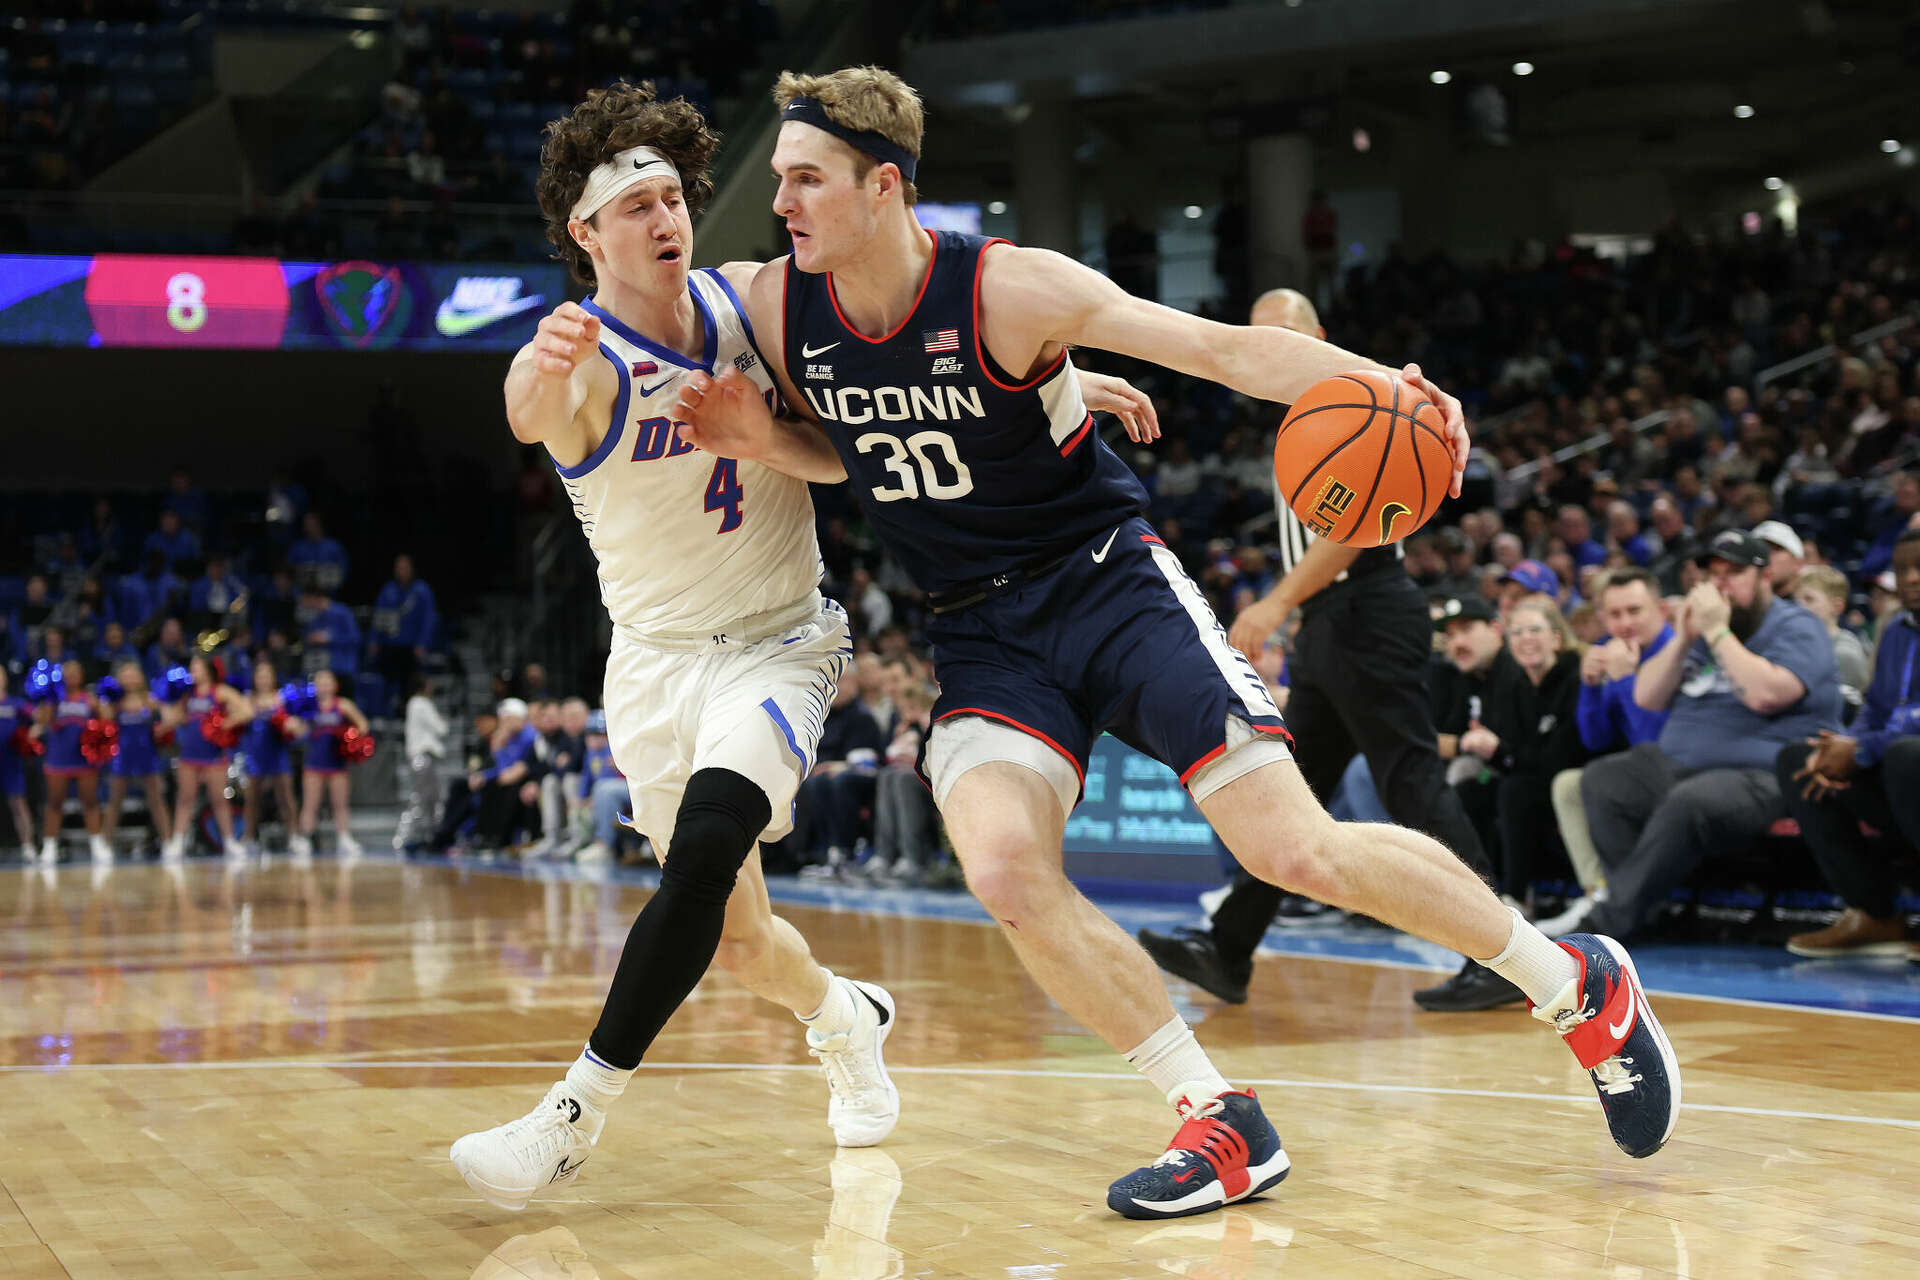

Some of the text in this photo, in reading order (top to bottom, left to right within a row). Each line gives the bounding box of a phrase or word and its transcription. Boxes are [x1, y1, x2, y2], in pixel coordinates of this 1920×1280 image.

[167, 272, 208, 332] 8
[806, 365, 833, 374] BE THE
[931, 364, 964, 372] EAST
[934, 357, 957, 366] BIG
[805, 372, 835, 381] CHANGE
[804, 386, 986, 425] UCONN
[855, 430, 974, 502] 30
[704, 456, 743, 535] 4
